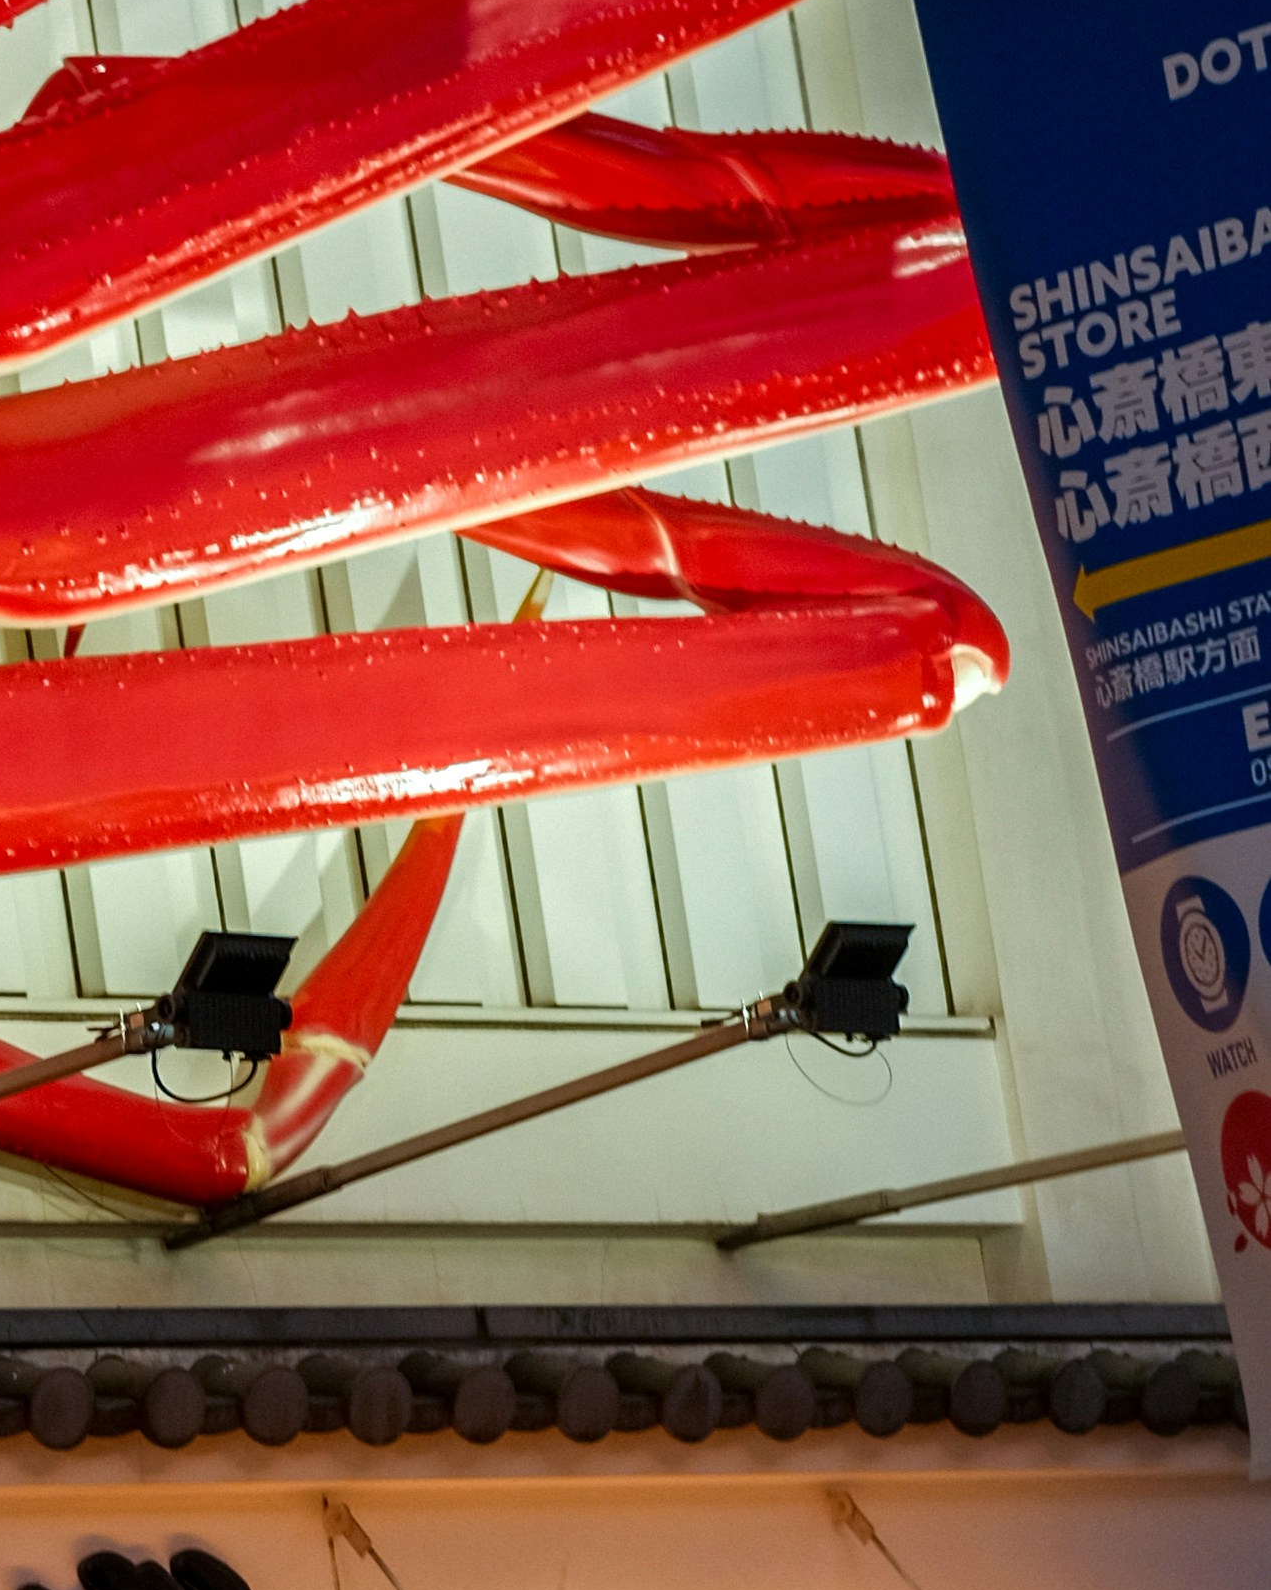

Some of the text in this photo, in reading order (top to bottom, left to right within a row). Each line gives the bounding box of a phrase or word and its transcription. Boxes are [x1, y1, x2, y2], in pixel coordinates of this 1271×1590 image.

[1019, 289, 1182, 380] STORE
[1085, 590, 1271, 671] SHINSAIBASHI STA
[1094, 625, 1261, 709] 心斎橋駅方面
[1206, 1037, 1258, 1079] WATCH
